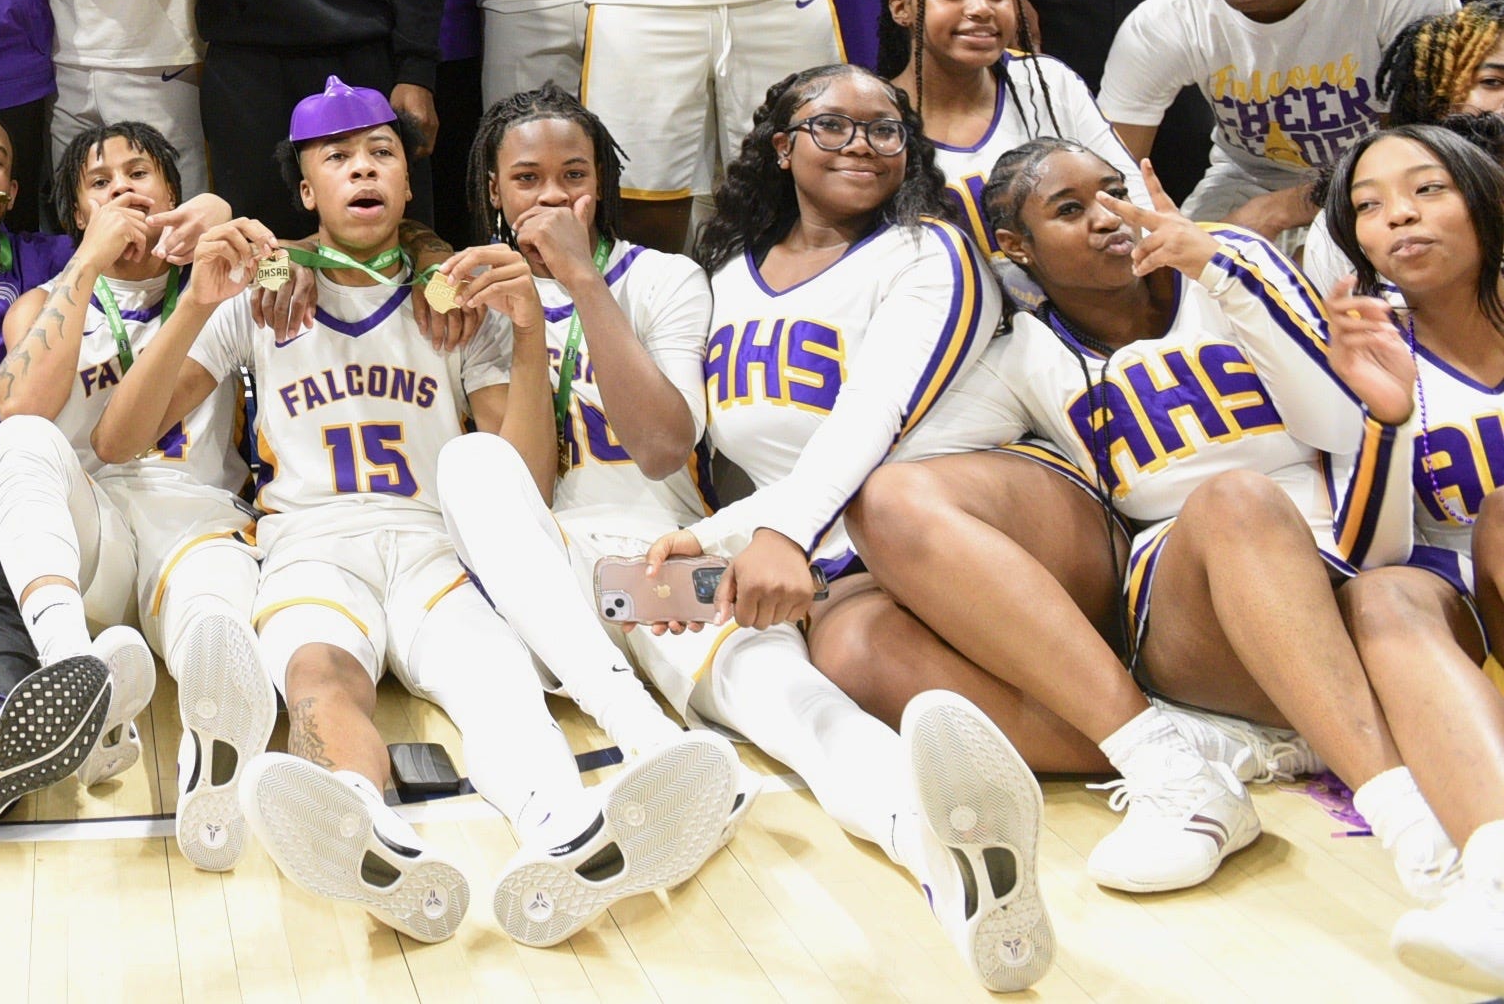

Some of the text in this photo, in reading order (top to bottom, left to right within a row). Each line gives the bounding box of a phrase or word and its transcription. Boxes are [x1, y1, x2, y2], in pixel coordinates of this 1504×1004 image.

[1210, 52, 1360, 104] Falcons
[258, 267, 288, 279] OHSAA
[278, 364, 439, 418] FALCONS
[706, 317, 848, 416] AHS
[1067, 340, 1286, 499] AHS
[320, 421, 422, 499] 15
